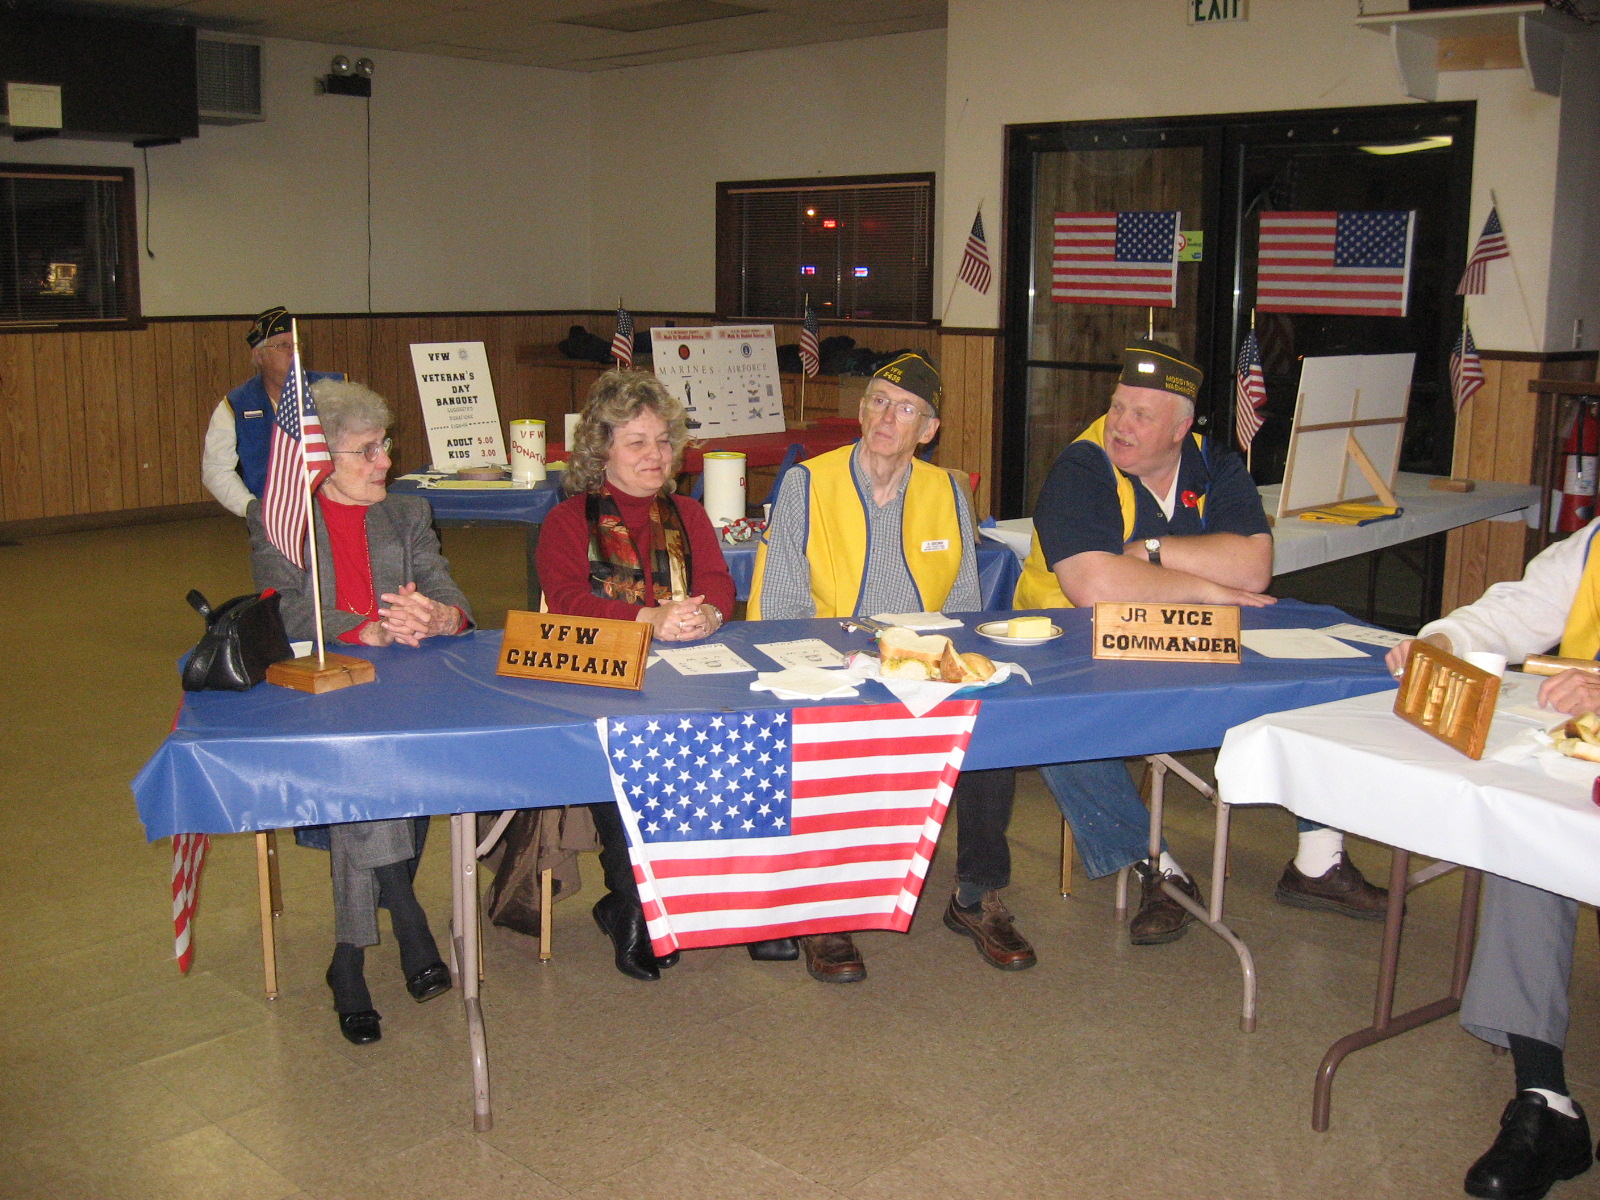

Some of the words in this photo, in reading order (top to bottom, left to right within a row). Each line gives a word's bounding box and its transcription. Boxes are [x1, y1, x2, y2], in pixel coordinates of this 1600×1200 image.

[428, 352, 450, 361] VFW
[659, 364, 714, 376] MARINES
[421, 371, 475, 382] VETERAN'S
[452, 384, 470, 394] DAY
[436, 396, 478, 406] BANQUET
[447, 438, 473, 447] ADULT
[477, 436, 494, 445] 5.00
[448, 451, 470, 459] KIDS
[481, 449, 496, 457] 3.00
[1120, 607, 1148, 623] JR
[1160, 609, 1214, 626] VICE
[540, 623, 600, 645] VFW
[1102, 633, 1238, 653] COMMANDER
[506, 648, 628, 677] CHAPLAIN
